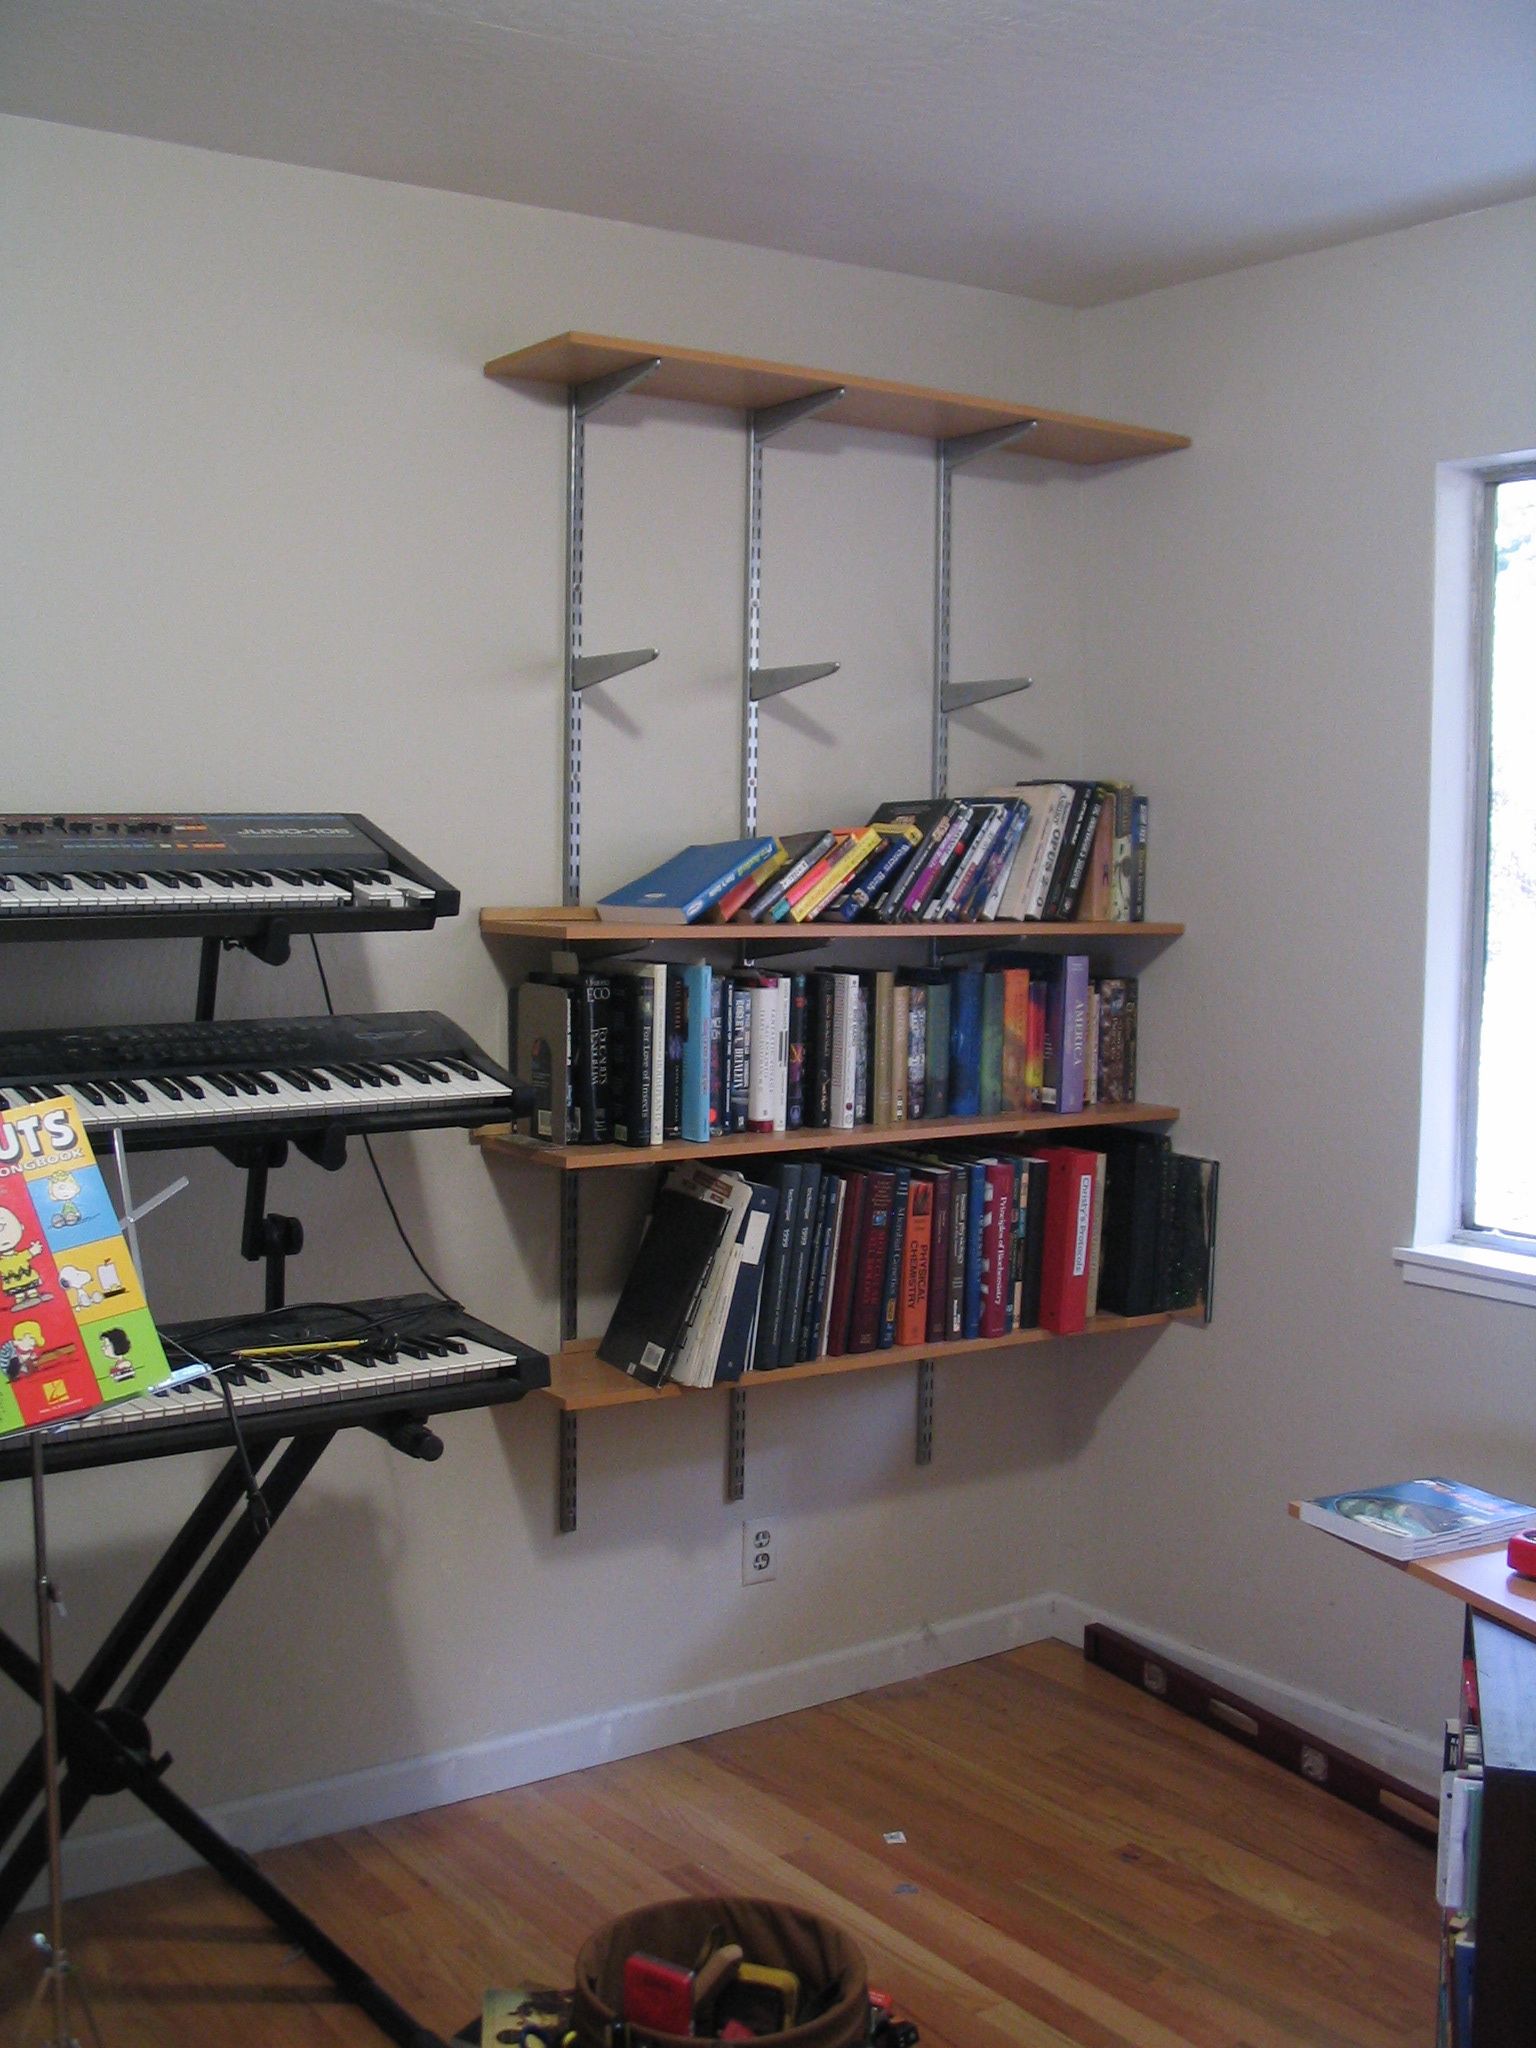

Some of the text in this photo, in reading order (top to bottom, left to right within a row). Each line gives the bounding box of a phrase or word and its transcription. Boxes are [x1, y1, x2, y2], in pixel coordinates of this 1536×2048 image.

[867, 844, 910, 890] Western Birds
[586, 987, 611, 1002] ECO
[1073, 1000, 1084, 1066] AMERICA
[643, 1071, 650, 1080] of
[642, 1083, 650, 1118] Insects
[781, 1229, 790, 1248] 1999
[799, 1227, 809, 1246] 1999
[894, 1207, 905, 1251] Microbial
[1075, 1177, 1090, 1274] Christy's Protocols
[994, 1196, 1007, 1305] Principles of Biochemistry
[907, 1240, 918, 1310] CHEMISTRY
[917, 1244, 928, 1303] PHYSICAL
